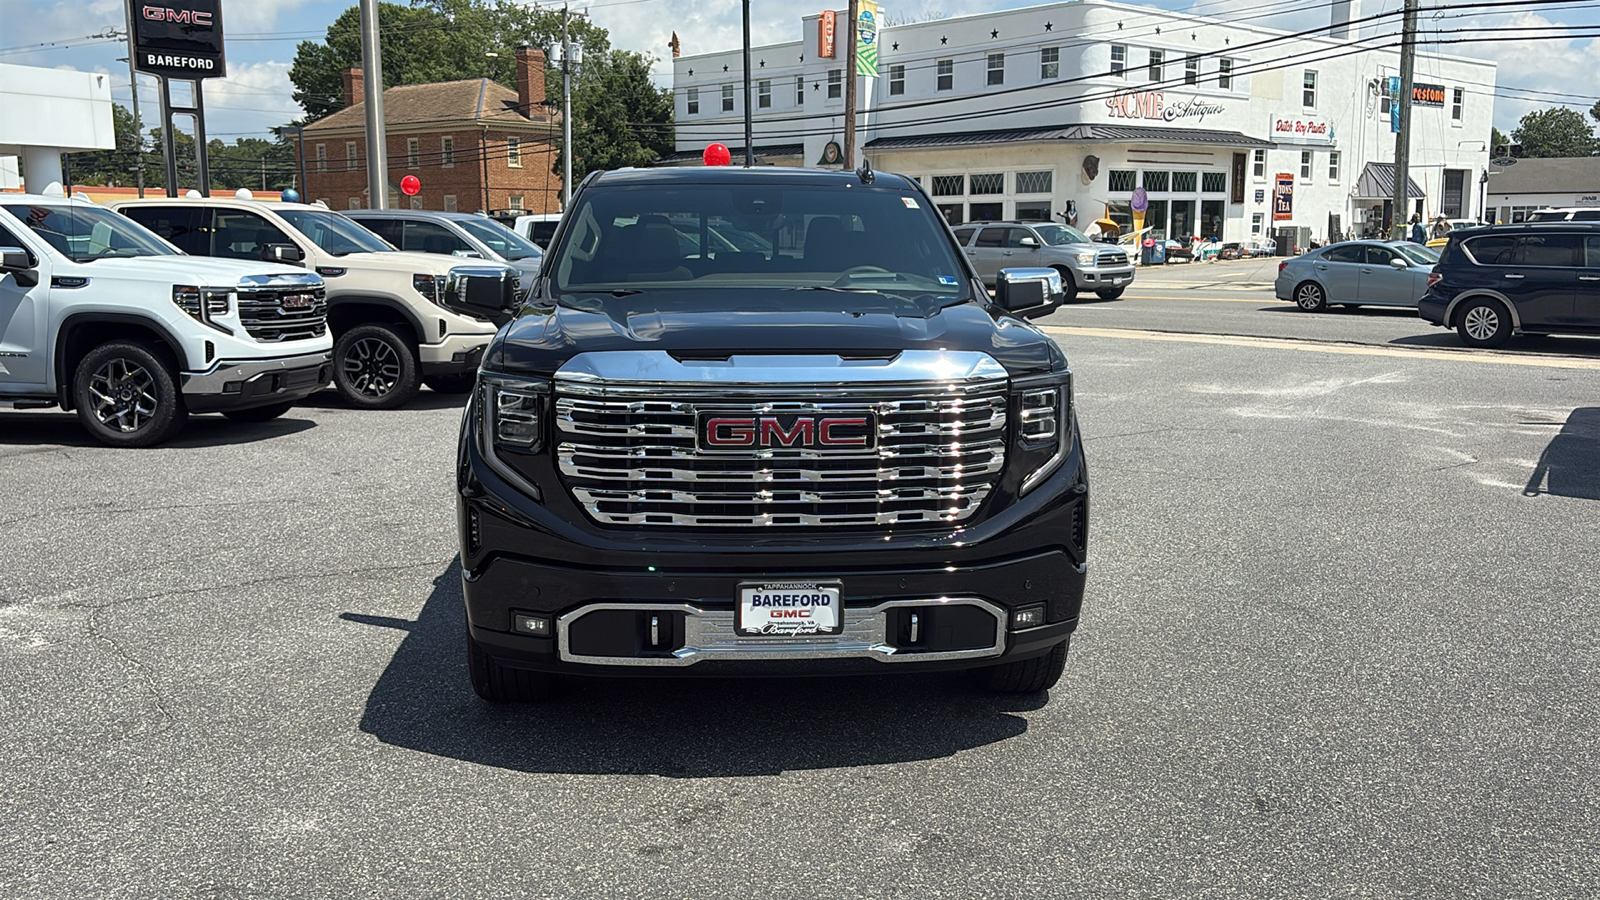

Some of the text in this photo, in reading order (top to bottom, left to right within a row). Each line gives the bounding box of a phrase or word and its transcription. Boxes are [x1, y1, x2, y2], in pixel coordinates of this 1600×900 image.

[142, 5, 213, 26] GMC
[147, 54, 214, 70] BAREFORD
[1412, 87, 1445, 102] restone
[1105, 88, 1164, 120] ACME
[1276, 119, 1327, 136] Dutch Boy Paints
[1278, 199, 1291, 212] TEA
[706, 417, 867, 446] GMC
[752, 594, 831, 607] BAREFORD
[770, 609, 811, 618] GMC
[761, 623, 820, 637] Bareford
